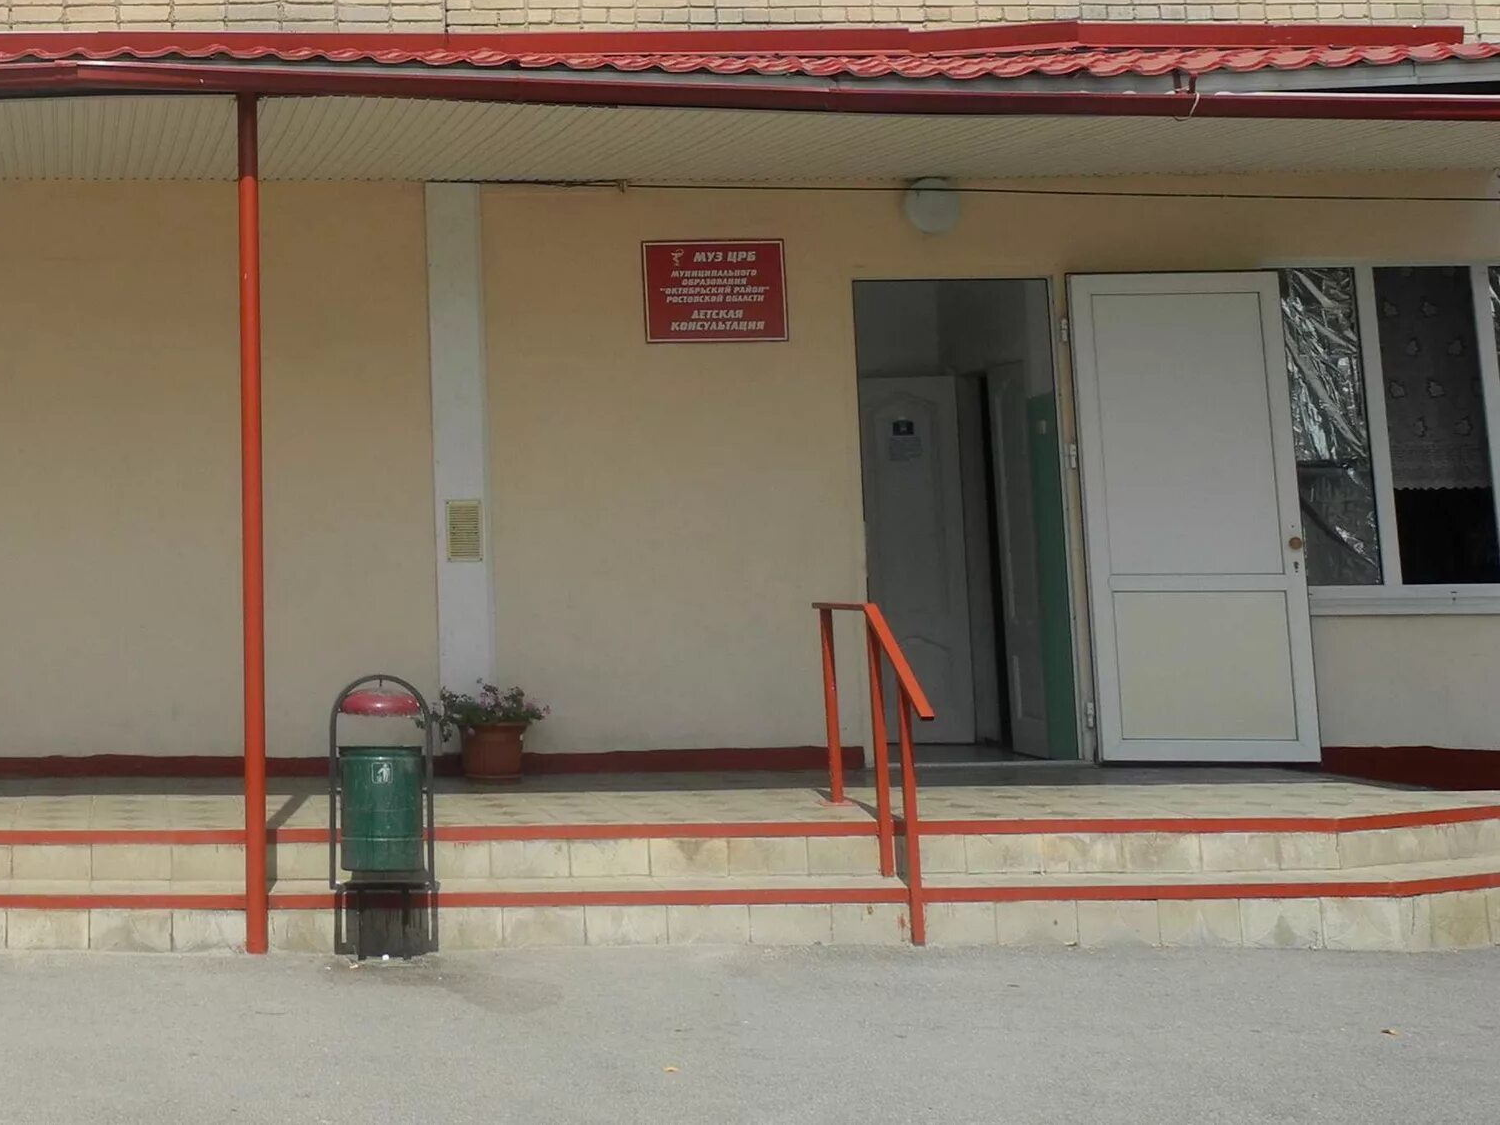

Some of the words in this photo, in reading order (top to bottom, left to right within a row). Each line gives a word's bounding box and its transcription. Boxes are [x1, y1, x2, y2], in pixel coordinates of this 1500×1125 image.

[693, 252, 723, 262] МУЗ
[727, 251, 756, 263] ЦРБ
[691, 310, 743, 319] ДЕТСКАЯ
[671, 321, 765, 331] КОНСУЛЬТАЦИЯ
